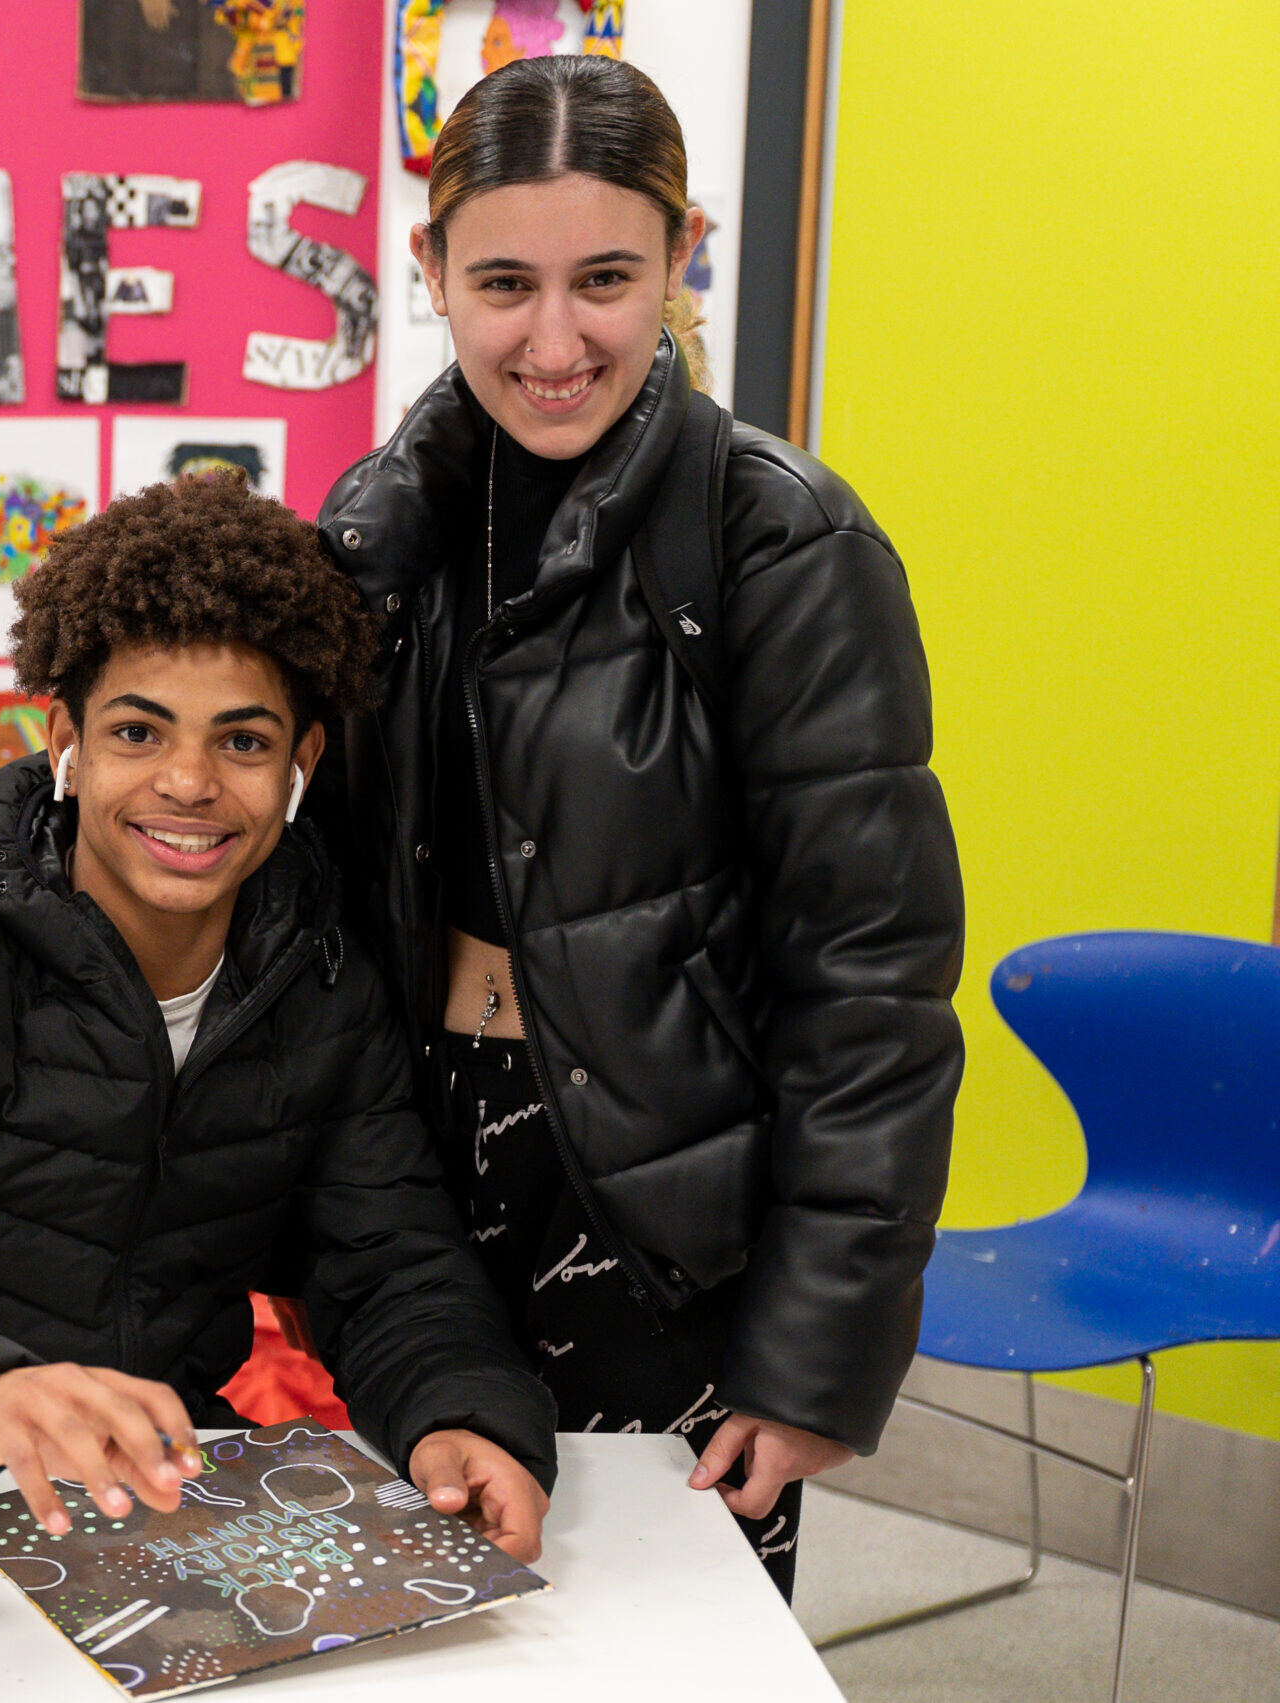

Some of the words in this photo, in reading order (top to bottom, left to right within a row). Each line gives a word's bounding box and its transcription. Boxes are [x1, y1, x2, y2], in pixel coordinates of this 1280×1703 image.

[146, 1501, 312, 1559] MONTH
[173, 1512, 354, 1581] HISTORY
[203, 1542, 354, 1598] BLACK
